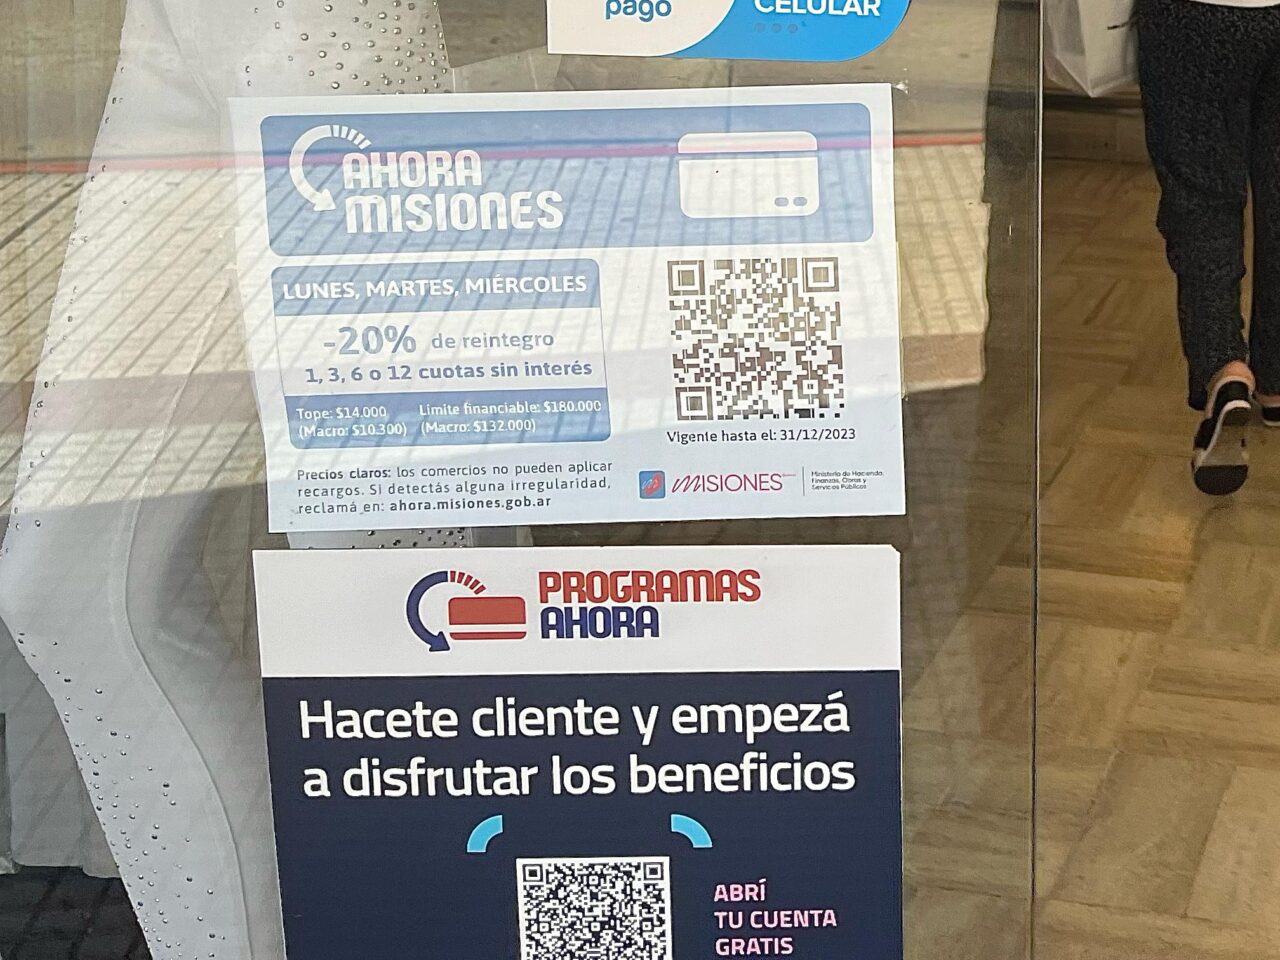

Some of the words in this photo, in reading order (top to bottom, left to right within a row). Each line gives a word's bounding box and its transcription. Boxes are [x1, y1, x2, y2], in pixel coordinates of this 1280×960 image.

[343, 149, 482, 189] AHORA
[345, 190, 564, 234] MISIONES
[283, 282, 360, 300] LUNES,
[366, 279, 459, 297] MARTES,
[465, 274, 587, 295] MIÉRCOLES
[324, 325, 416, 355] -20%
[432, 333, 456, 349] de
[462, 331, 554, 351] reintegro
[306, 369, 322, 385] 1,
[328, 368, 345, 384] 3,
[351, 367, 363, 381] 6
[370, 370, 381, 381] o
[388, 365, 412, 380] 12
[419, 364, 485, 379] cuotas
[490, 362, 518, 377] sin
[525, 360, 592, 376] interés
[296, 409, 333, 421] Tope:
[336, 406, 386, 418] $14.000
[544, 400, 601, 412] $180.000
[667, 431, 717, 445] Vigente
[721, 430, 757, 441] hasta
[761, 430, 777, 441] el:
[780, 428, 856, 441] 31/12/2023
[298, 470, 343, 480] Precios
[350, 468, 391, 478] claros:
[397, 467, 415, 477] los
[421, 465, 487, 477] comercios
[493, 466, 508, 474] no
[515, 463, 562, 476] pueden
[568, 461, 612, 474] aplicar
[298, 487, 364, 499] recargos.
[388, 482, 450, 495] detectás
[456, 481, 505, 495] alguna
[672, 473, 783, 494] MISIONES
[299, 502, 357, 514] reclamá
[364, 502, 385, 512] en:
[390, 496, 551, 512] ahora.misiones.gob.ar
[539, 569, 761, 604] PROGRAMAS
[540, 605, 660, 639] AHORA
[300, 699, 459, 739] Hacete
[472, 697, 620, 737] cliente
[632, 703, 659, 745] y
[672, 691, 850, 744] empezá
[304, 765, 330, 798] a
[343, 758, 539, 798] disfrutar
[552, 755, 617, 795] los
[630, 752, 855, 794] beneficios
[714, 878, 767, 902] ABRÍ
[714, 911, 743, 928] TU
[750, 909, 837, 928] CUENTA
[715, 938, 793, 955] GRATIS
